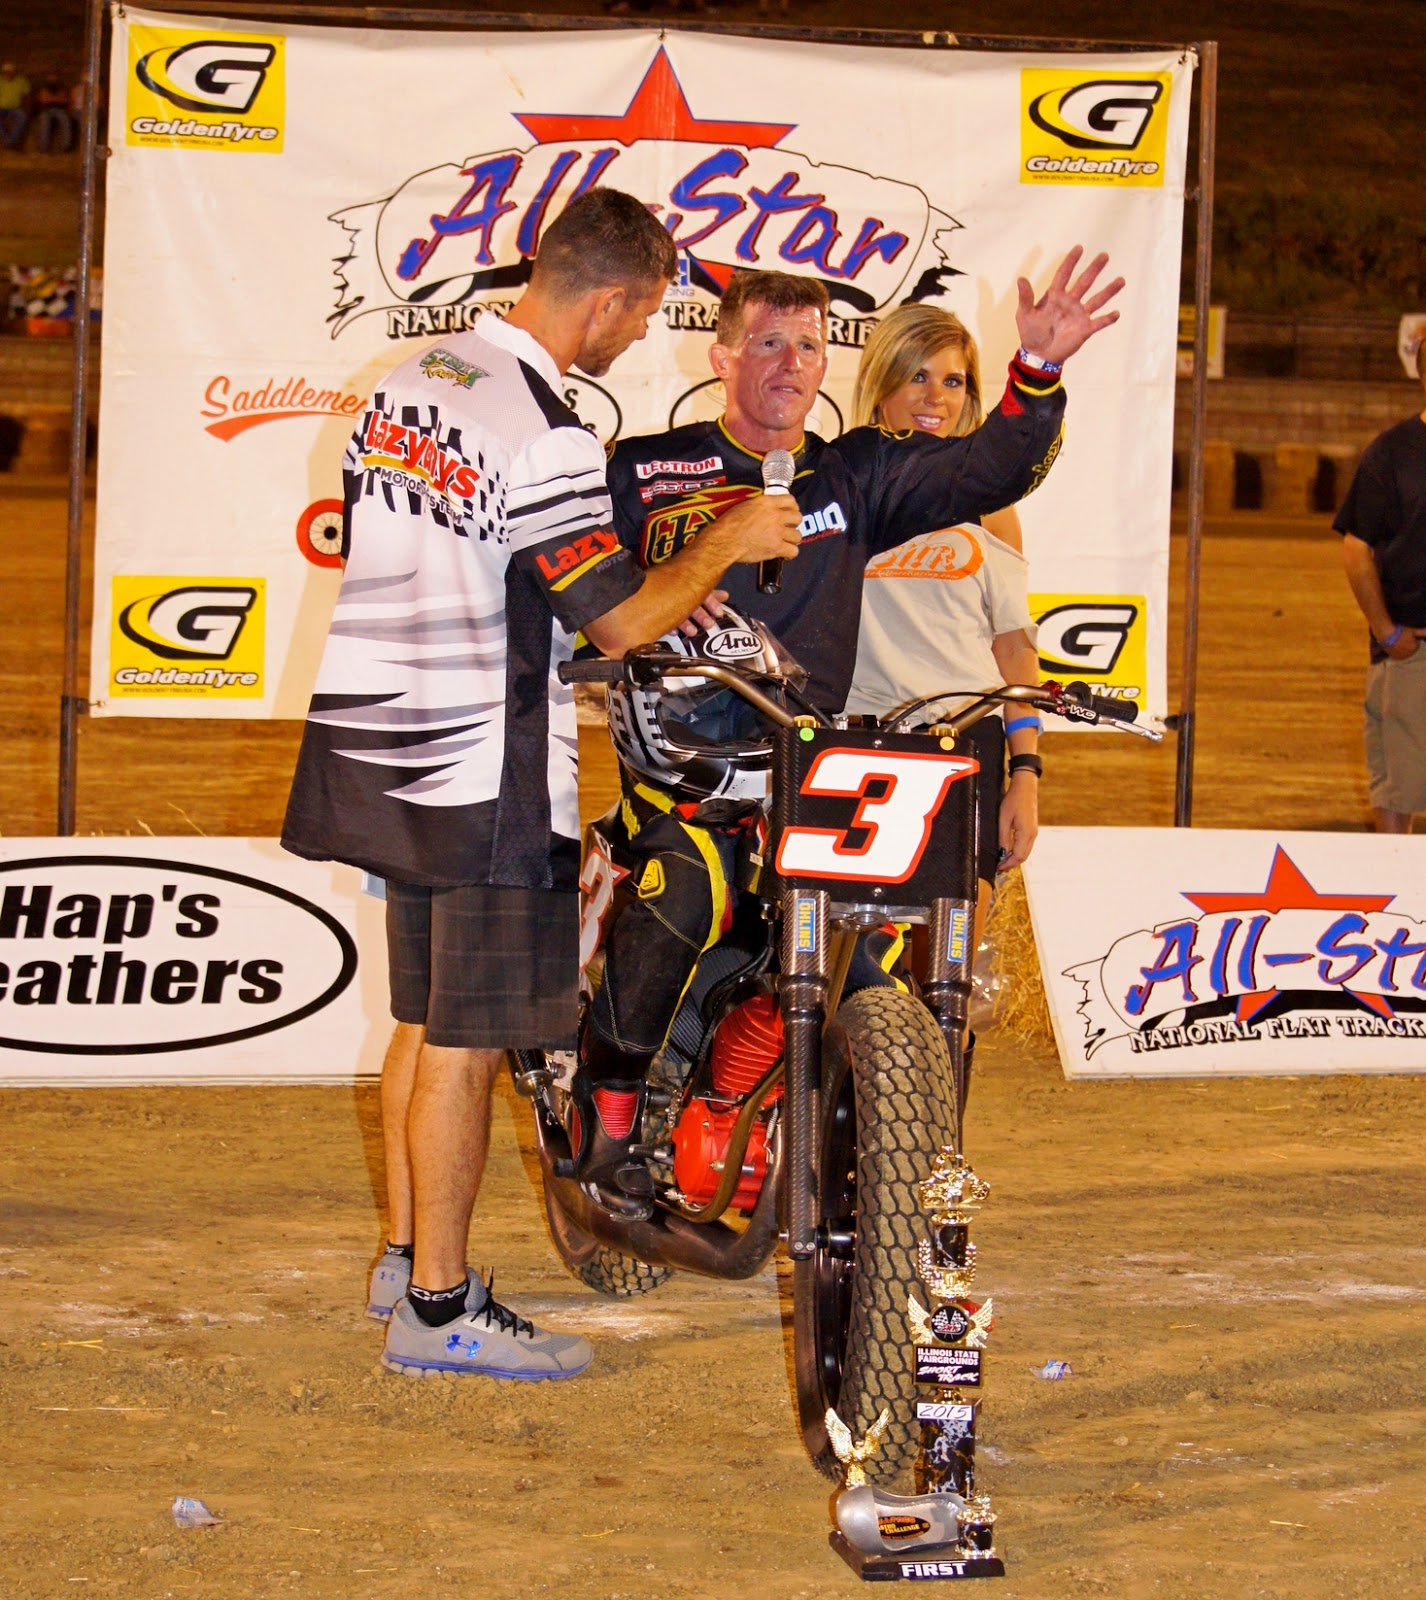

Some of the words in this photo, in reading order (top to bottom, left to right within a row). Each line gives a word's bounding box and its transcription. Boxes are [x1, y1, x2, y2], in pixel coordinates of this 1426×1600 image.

[131, 117, 279, 142] GoldenTyre
[1026, 156, 1160, 178] GoldenTyre
[387, 301, 516, 339] NATION
[662, 301, 721, 333] TRA
[642, 458, 717, 477] LECTRON
[713, 632, 759, 654] Arai
[115, 667, 259, 688] GoldenTyre
[775, 746, 981, 884] 3
[0, 884, 221, 945] Hap's
[1123, 913, 1426, 1016] All-St
[0, 951, 285, 1005] athers
[1129, 1019, 1263, 1054] NATIONAL
[1265, 1015, 1332, 1039] FLAT
[1335, 1015, 1426, 1039] TRACK
[917, 1347, 953, 1357] ILLINOIS
[954, 1350, 980, 1359] STATE
[917, 1355, 979, 1366] FAIRGROUNDS
[916, 1365, 963, 1376] SHORT
[937, 1372, 980, 1384] TRACK
[919, 1404, 971, 1419] 2015
[901, 1562, 967, 1578] FIRST
